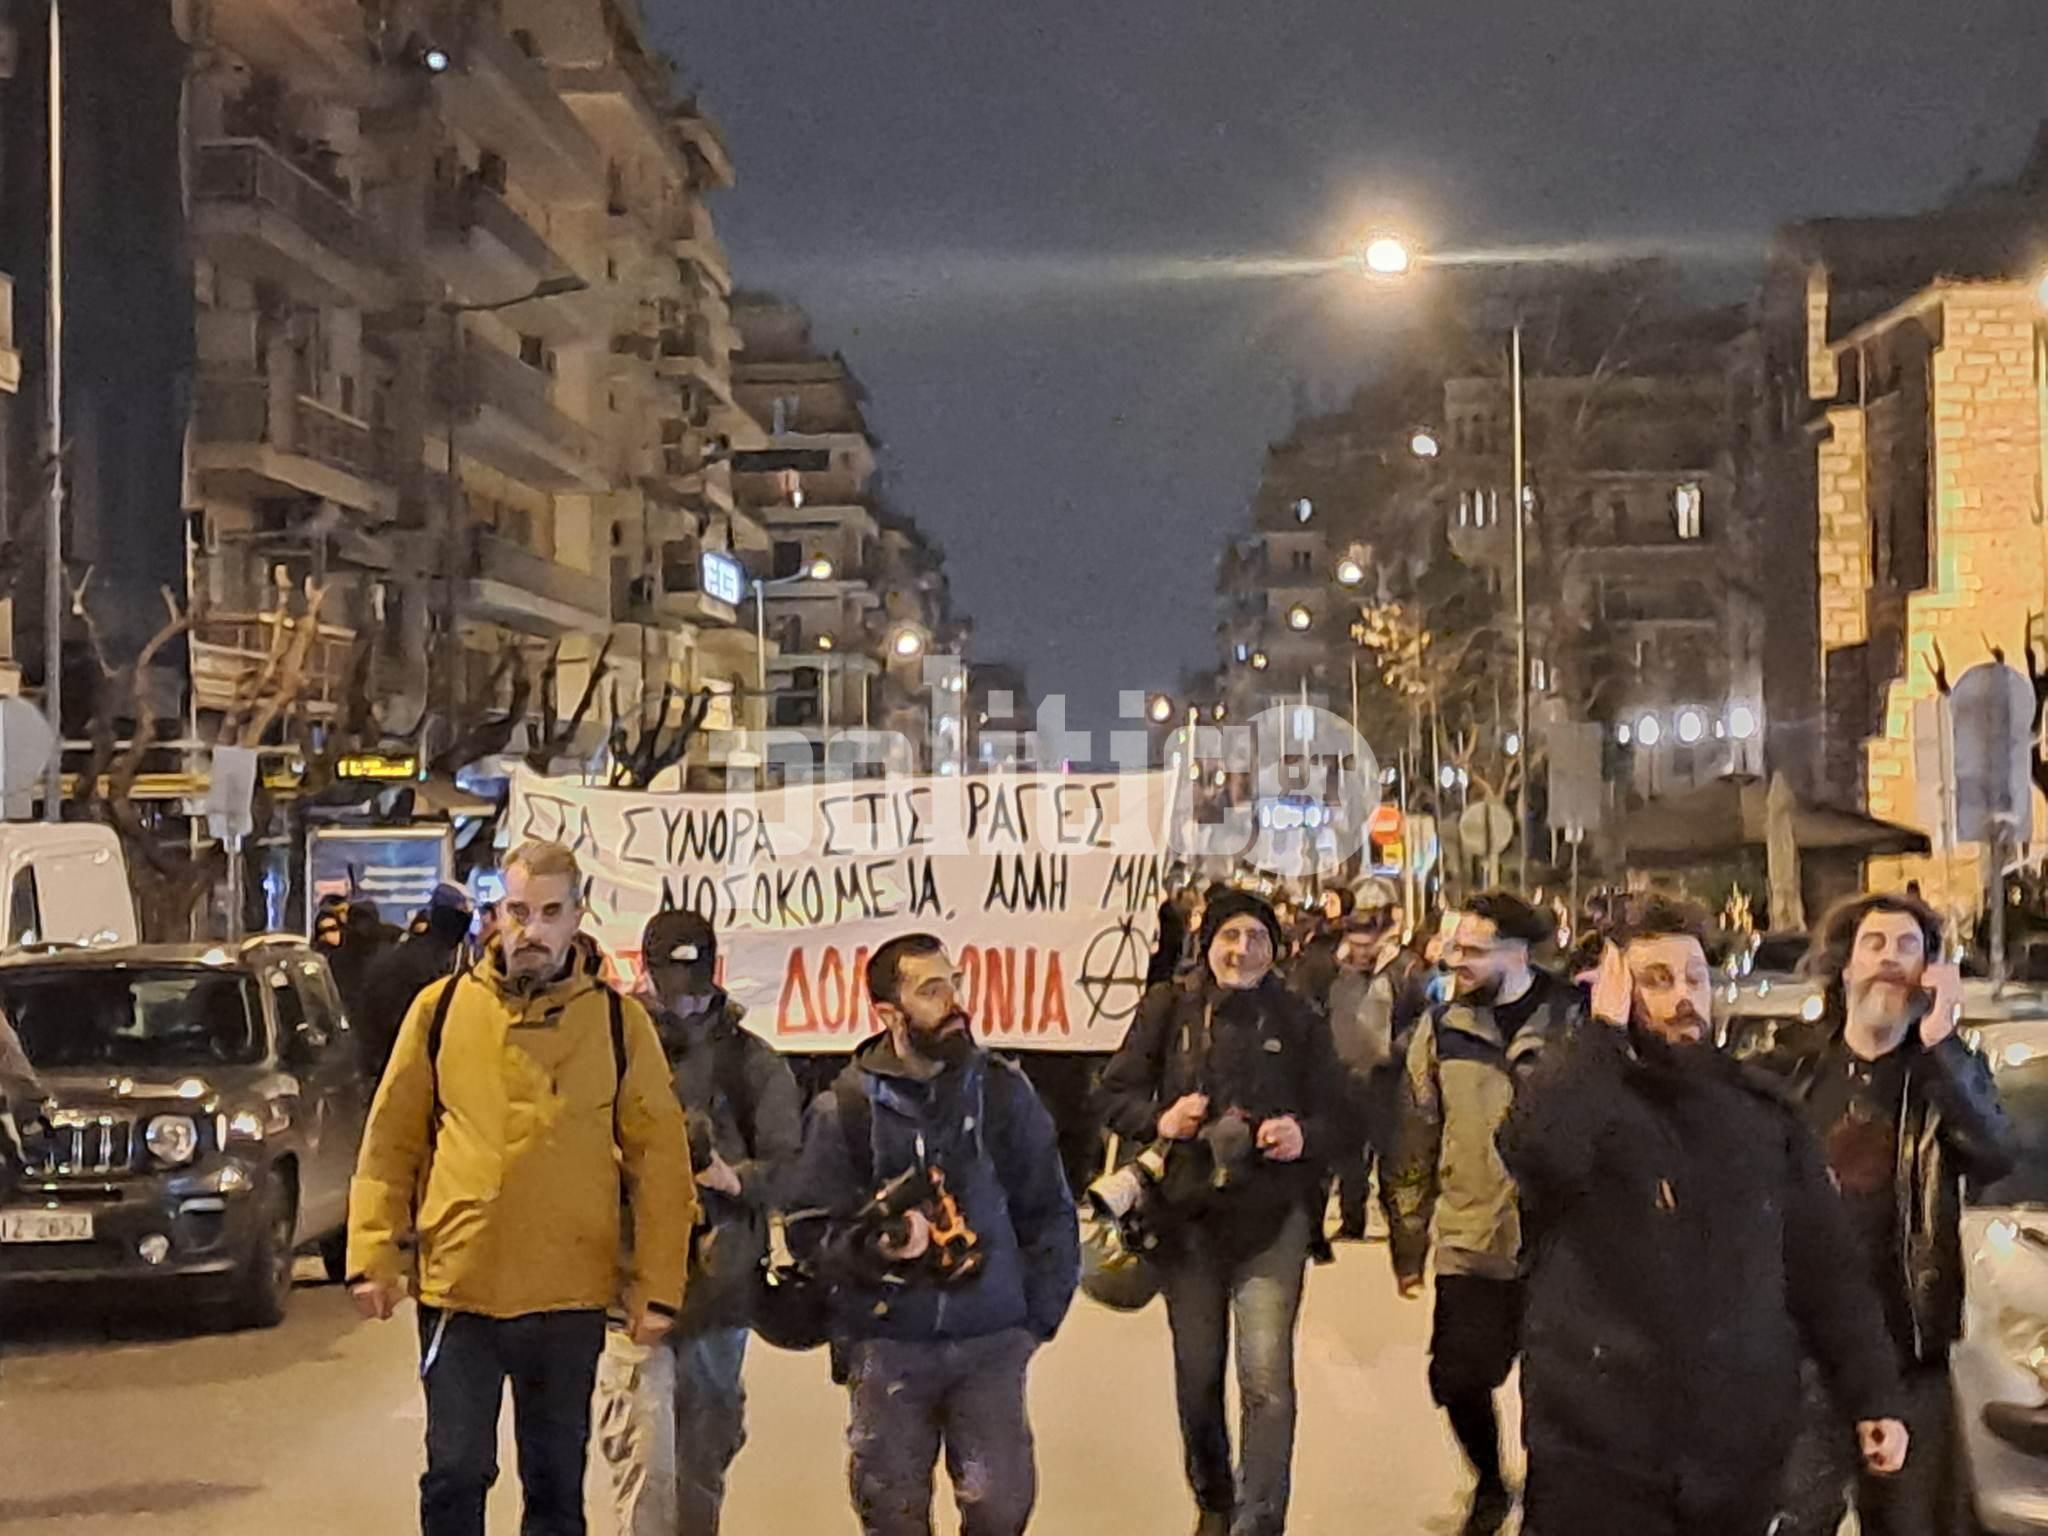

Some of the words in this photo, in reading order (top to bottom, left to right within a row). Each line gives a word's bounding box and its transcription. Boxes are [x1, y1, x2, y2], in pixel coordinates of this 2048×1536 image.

[523, 793, 599, 858] ΣΤΑ
[619, 806, 777, 866] ΣΥΝΟΡΑ
[819, 787, 934, 856] ΣΤΙΣ
[967, 781, 1117, 848] ΡΑΓΕΣ
[1101, 853, 1160, 913] ΜΙΑ
[776, 945, 1070, 1036] ΔΟΛΟΝΙΑ
